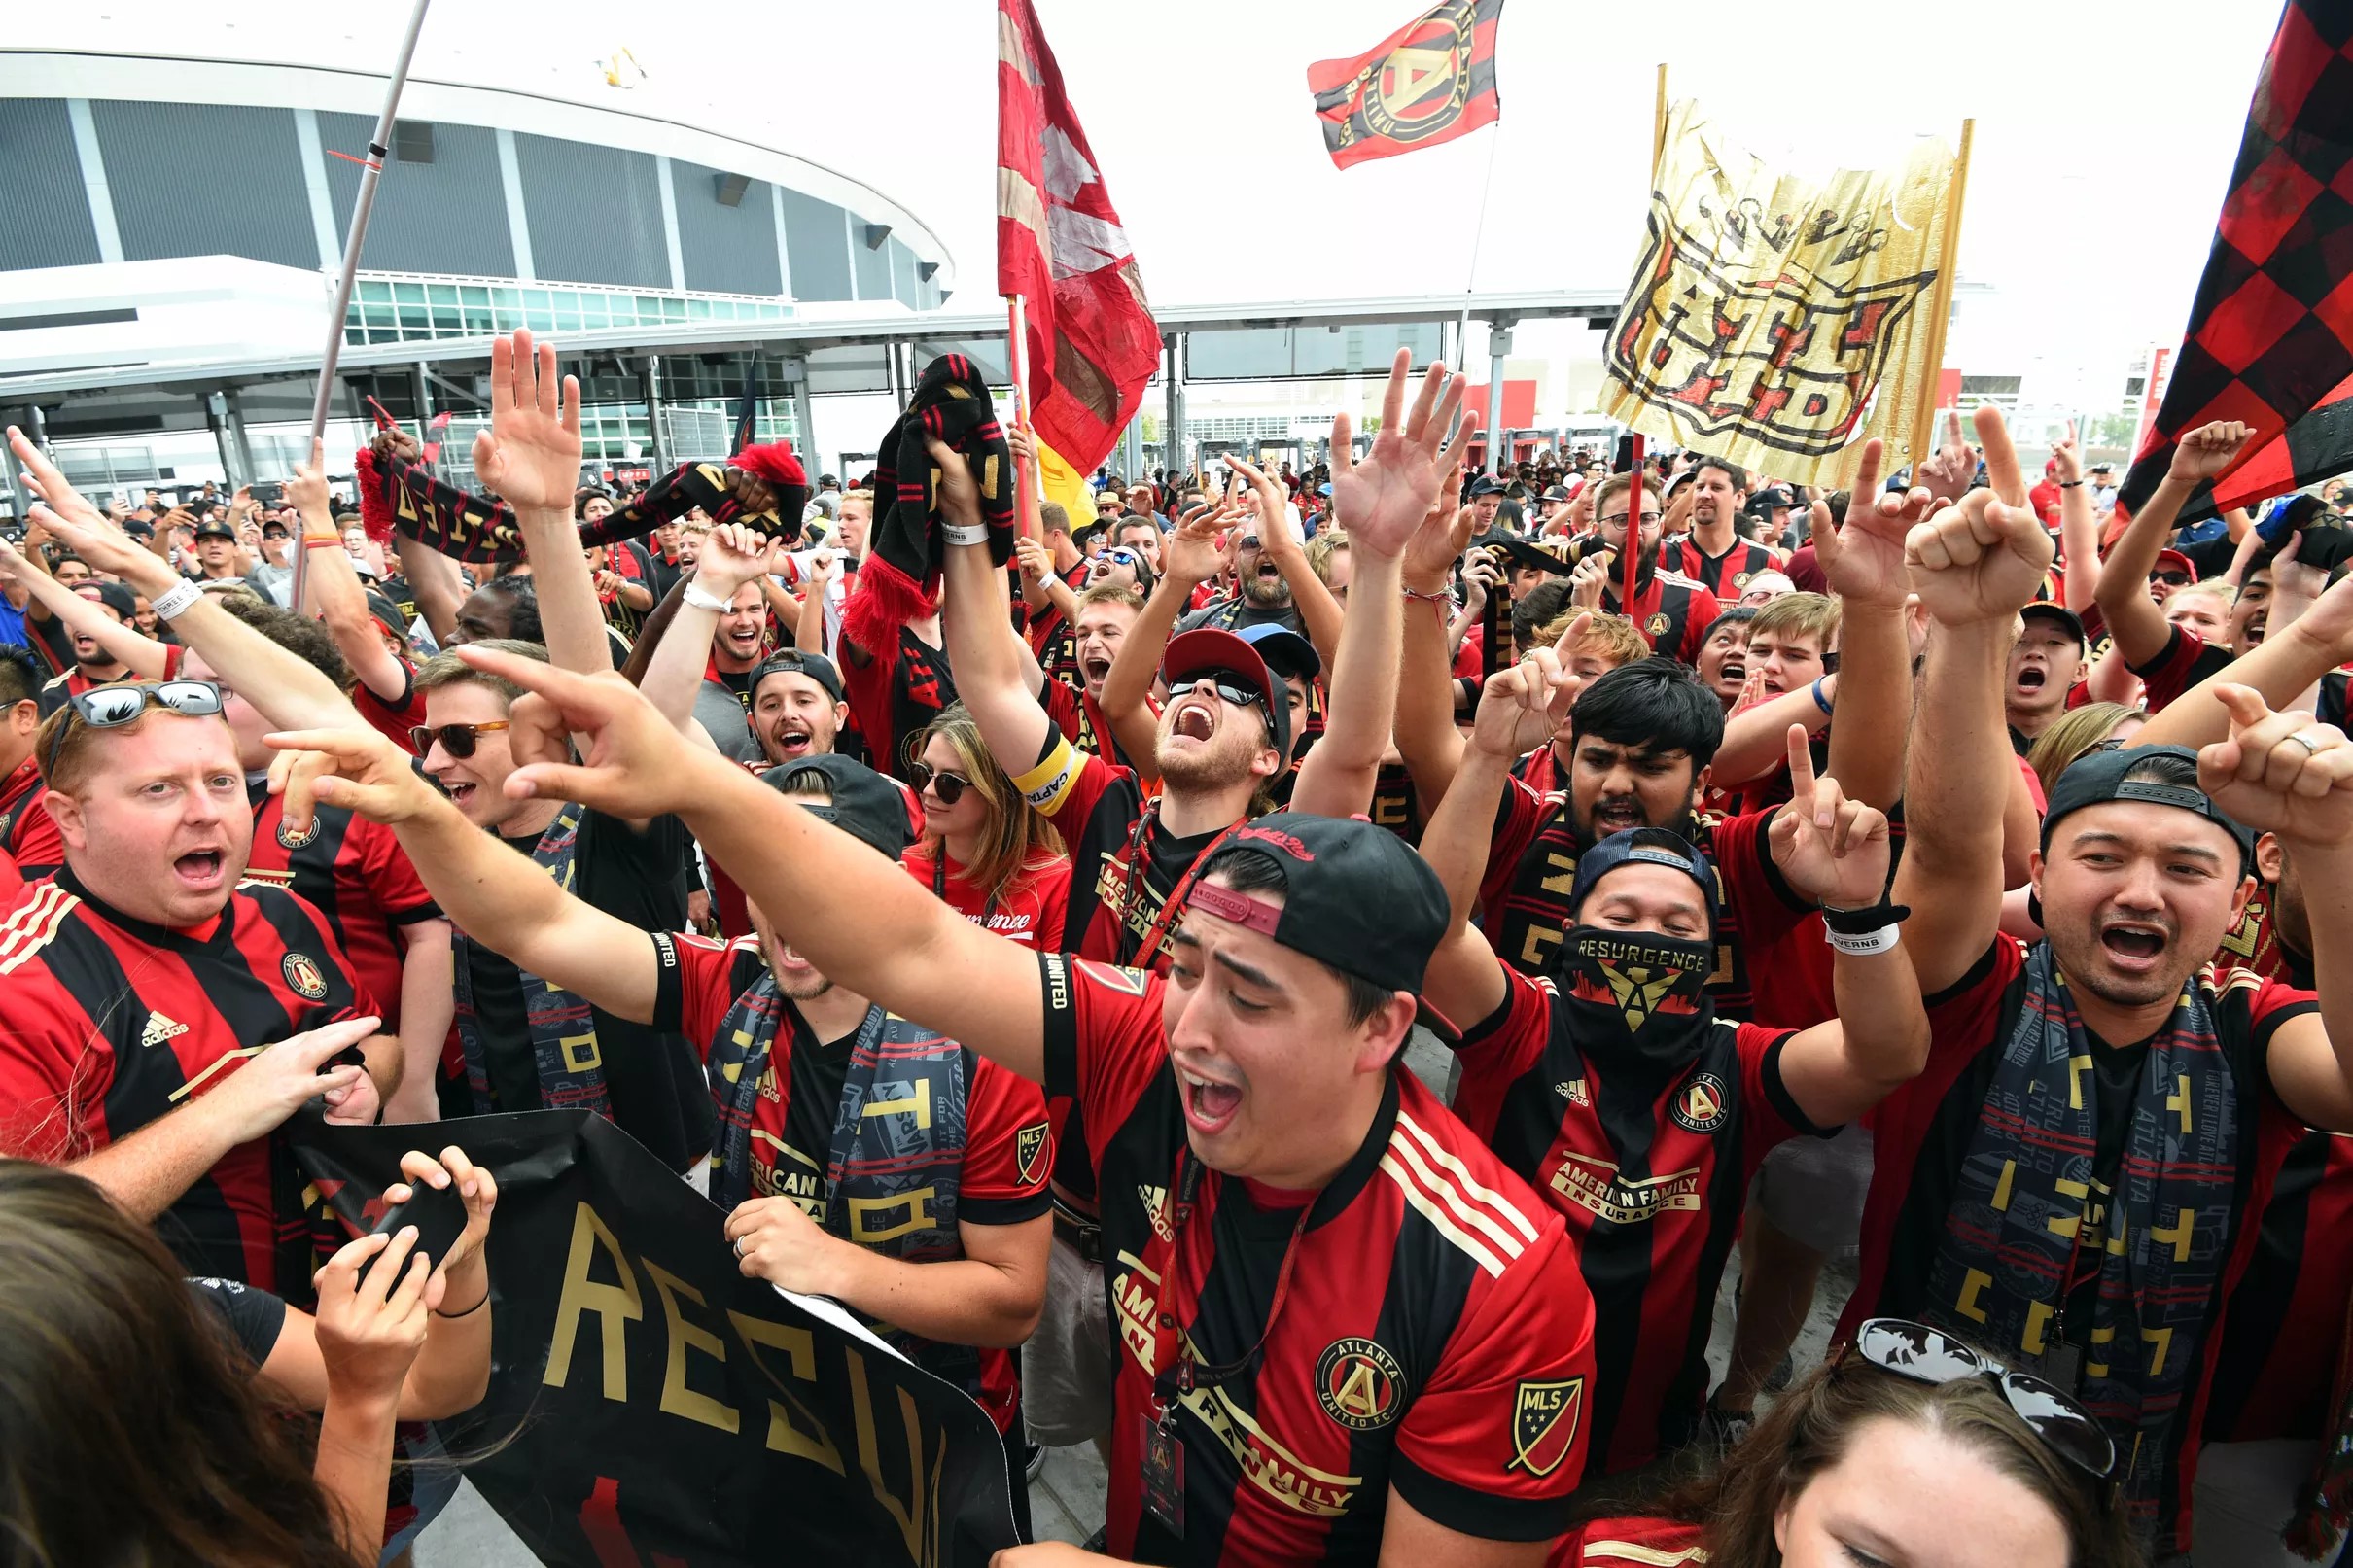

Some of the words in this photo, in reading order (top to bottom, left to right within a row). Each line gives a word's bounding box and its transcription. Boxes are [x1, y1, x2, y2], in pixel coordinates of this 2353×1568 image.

[1029, 772, 1069, 803] CAPTA
[1578, 939, 1705, 973] RESURGENCE
[141, 1022, 190, 1048] adidas
[937, 1096, 947, 1124] FOR
[1554, 1083, 1590, 1108] adidas
[1681, 1115, 1717, 1129] UNITED
[1718, 1107, 1728, 1120] FC
[1021, 1130, 1041, 1147] MLS
[749, 1152, 818, 1198] ERICAN
[1639, 1177, 1698, 1205] FAMILY
[1137, 1184, 1175, 1243] adidas
[1563, 1182, 1686, 1221] INSURANCE
[1337, 1342, 1399, 1378] ATLANTA
[543, 1201, 948, 1568] RESU
[1523, 1390, 1562, 1411] MLS
[1321, 1392, 1367, 1427] UNITED
[1373, 1412, 1390, 1425] FC
[1235, 1427, 1354, 1508] AMILY
